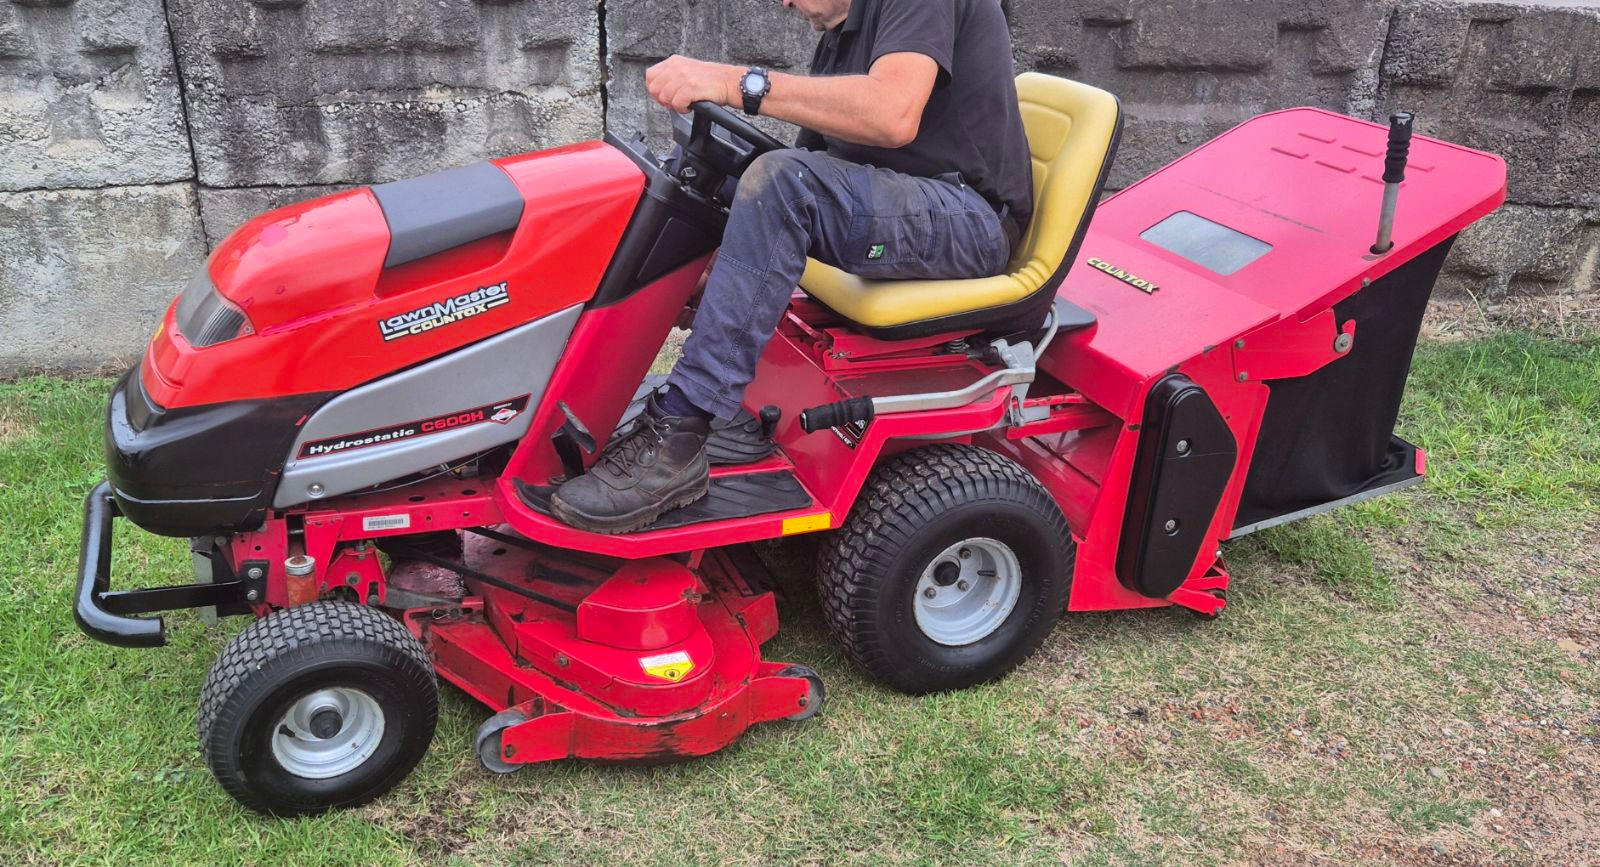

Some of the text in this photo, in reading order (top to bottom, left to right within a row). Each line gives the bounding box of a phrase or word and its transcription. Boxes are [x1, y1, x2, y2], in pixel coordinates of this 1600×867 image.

[379, 282, 507, 334] LawnMaster
[309, 410, 484, 455] Hydrostatic C600H
